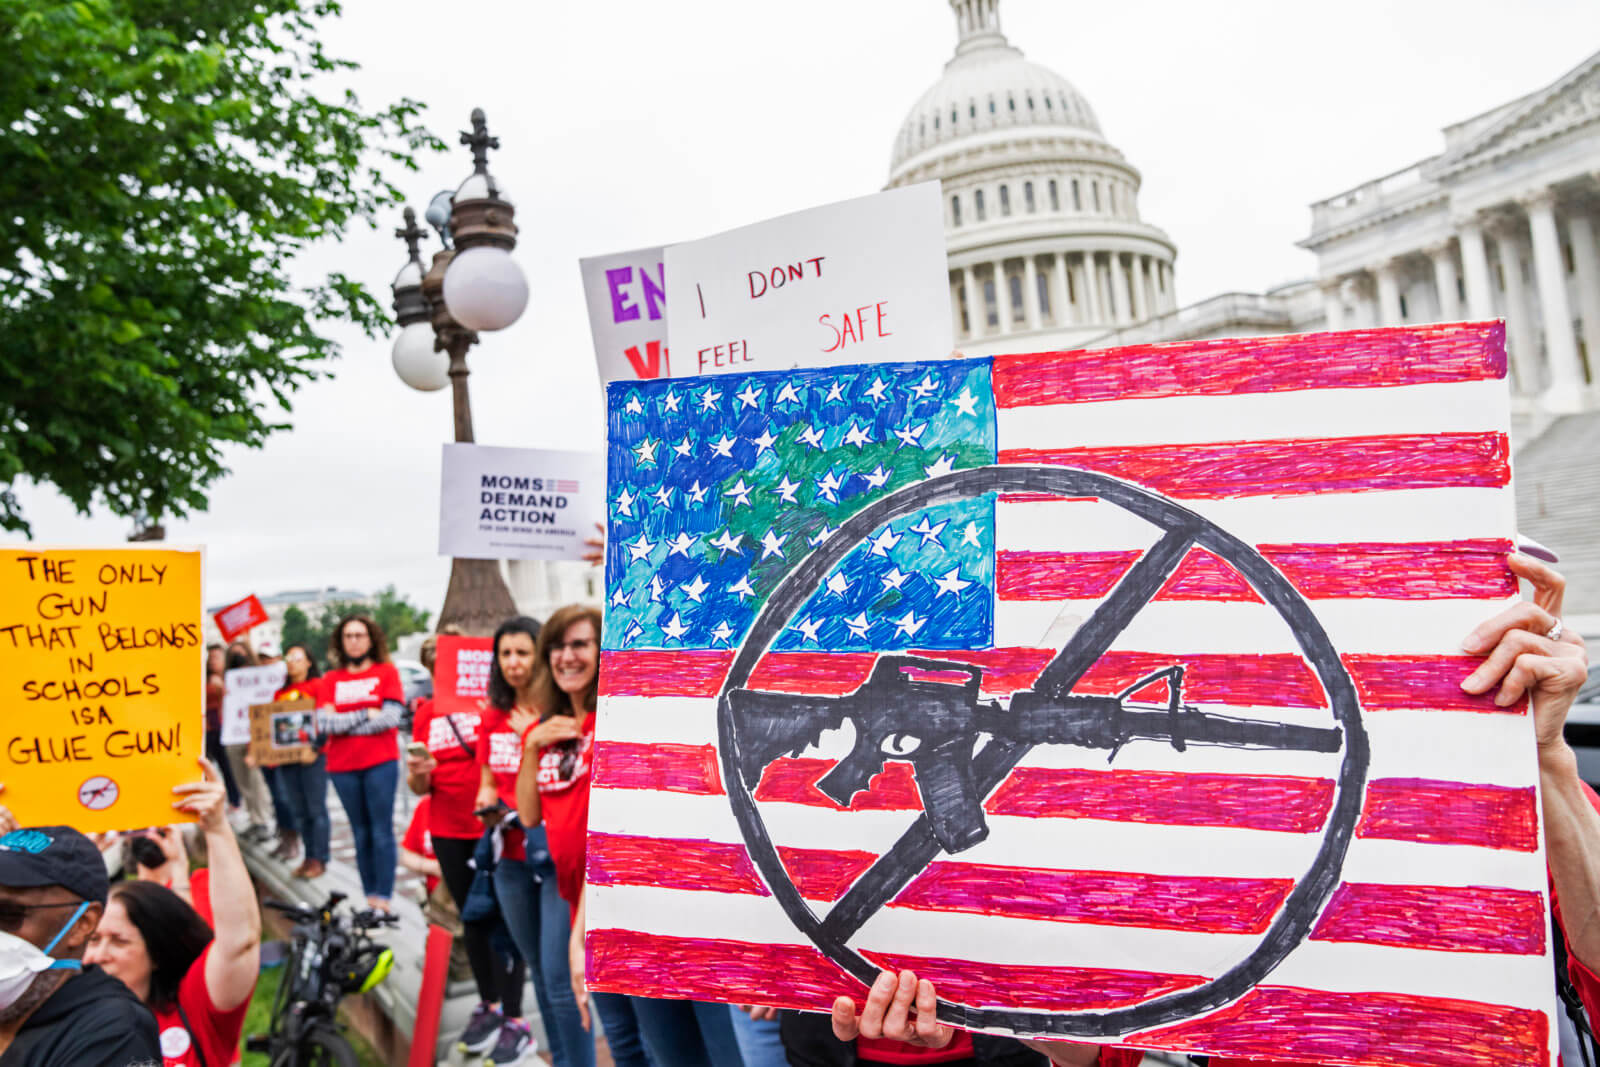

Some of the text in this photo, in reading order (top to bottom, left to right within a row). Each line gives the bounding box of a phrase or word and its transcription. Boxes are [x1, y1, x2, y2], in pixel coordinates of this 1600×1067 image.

[697, 256, 826, 319] I DONT
[698, 301, 892, 374] FEEL SAFE
[481, 474, 544, 491] MOMS
[481, 491, 568, 509] DEMAND
[480, 508, 556, 525] ACTION
[17, 556, 167, 585] THE ONLY
[38, 591, 107, 620] GUN
[0, 623, 199, 652] THAT BELONGS
[69, 653, 94, 674] IN
[23, 674, 160, 701] SCHOOLS
[8, 723, 181, 764] GLUE GUN!
